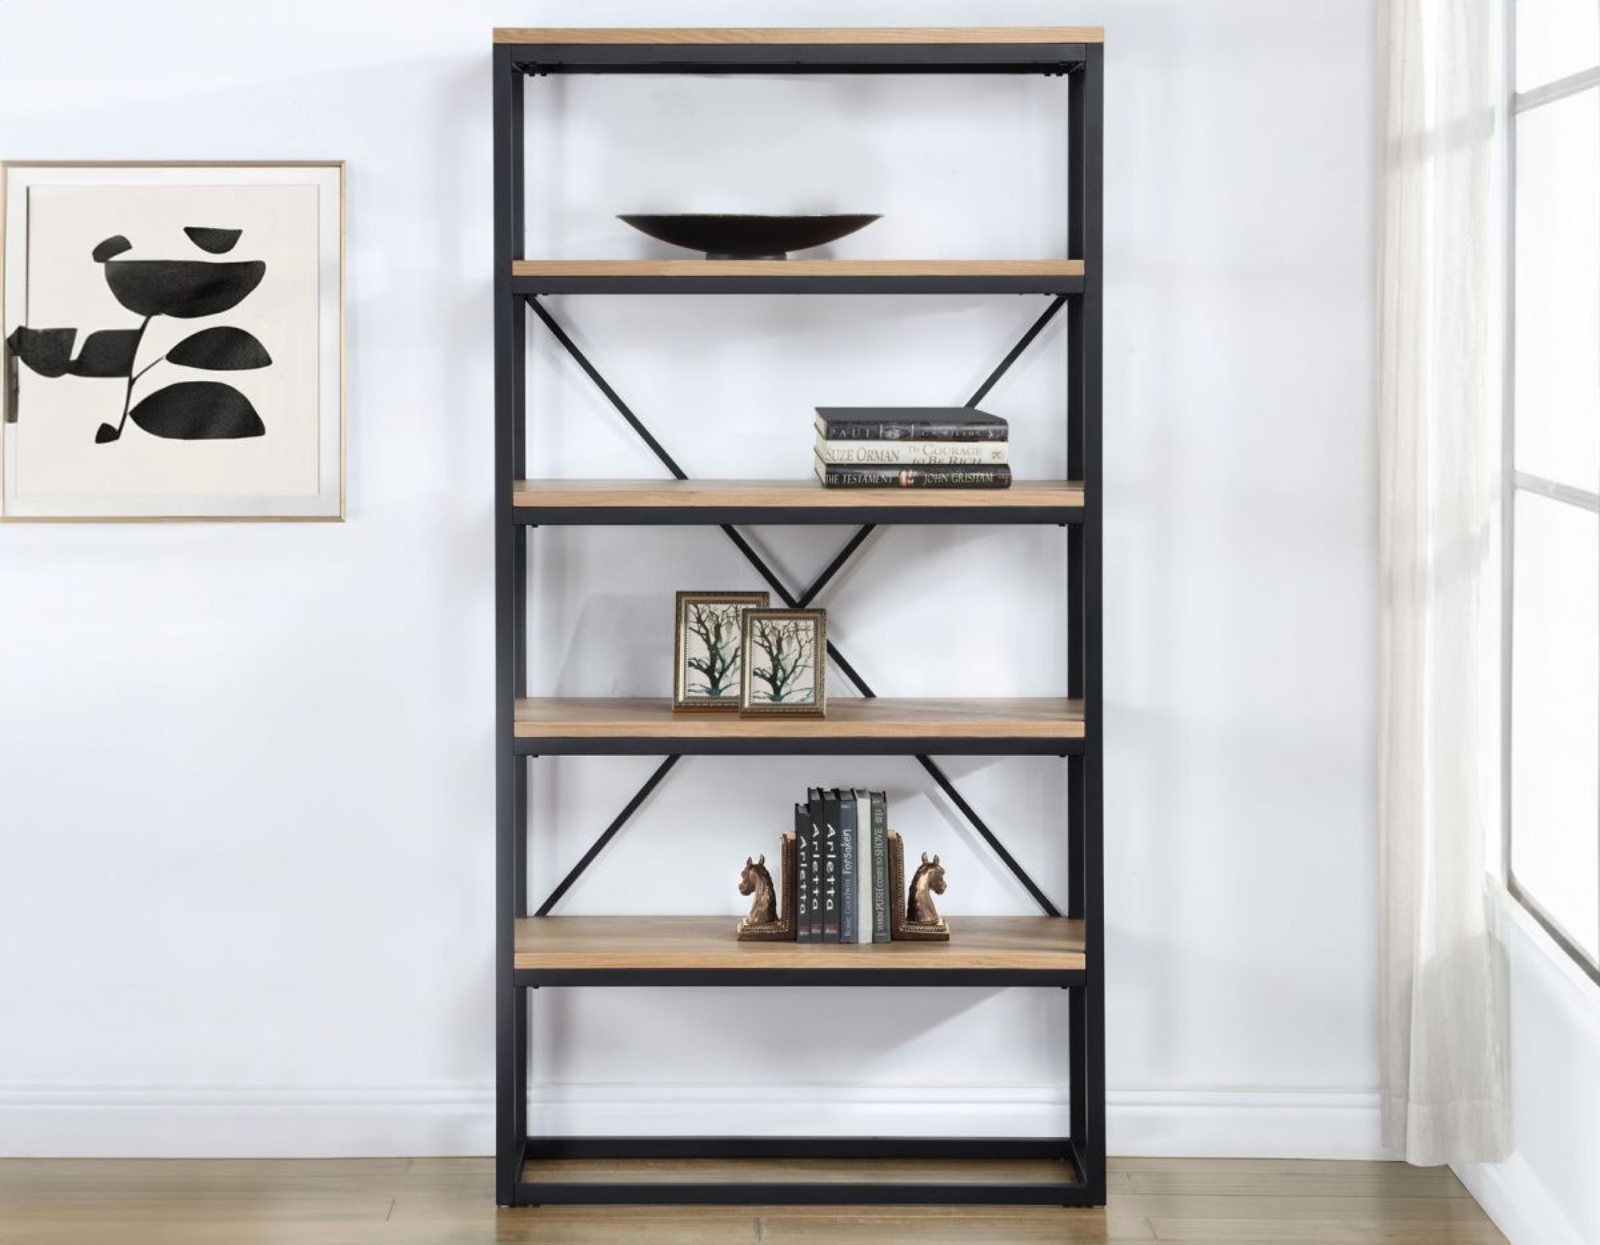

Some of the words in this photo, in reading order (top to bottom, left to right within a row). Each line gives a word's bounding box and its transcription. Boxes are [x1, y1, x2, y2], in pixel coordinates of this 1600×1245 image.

[826, 450, 854, 462] SUZE
[856, 447, 899, 462] ORMAN
[826, 473, 839, 484] THE
[842, 473, 893, 484] TESTAMENT
[923, 473, 949, 485] JOHN
[951, 472, 994, 484] GRISHAM
[841, 828, 853, 875] Forsaken
[873, 828, 884, 857] SHOVE
[798, 836, 808, 915] Arletta
[812, 823, 821, 911] Arletta
[826, 823, 837, 912] Arletta
[875, 889, 885, 911] PUSH
